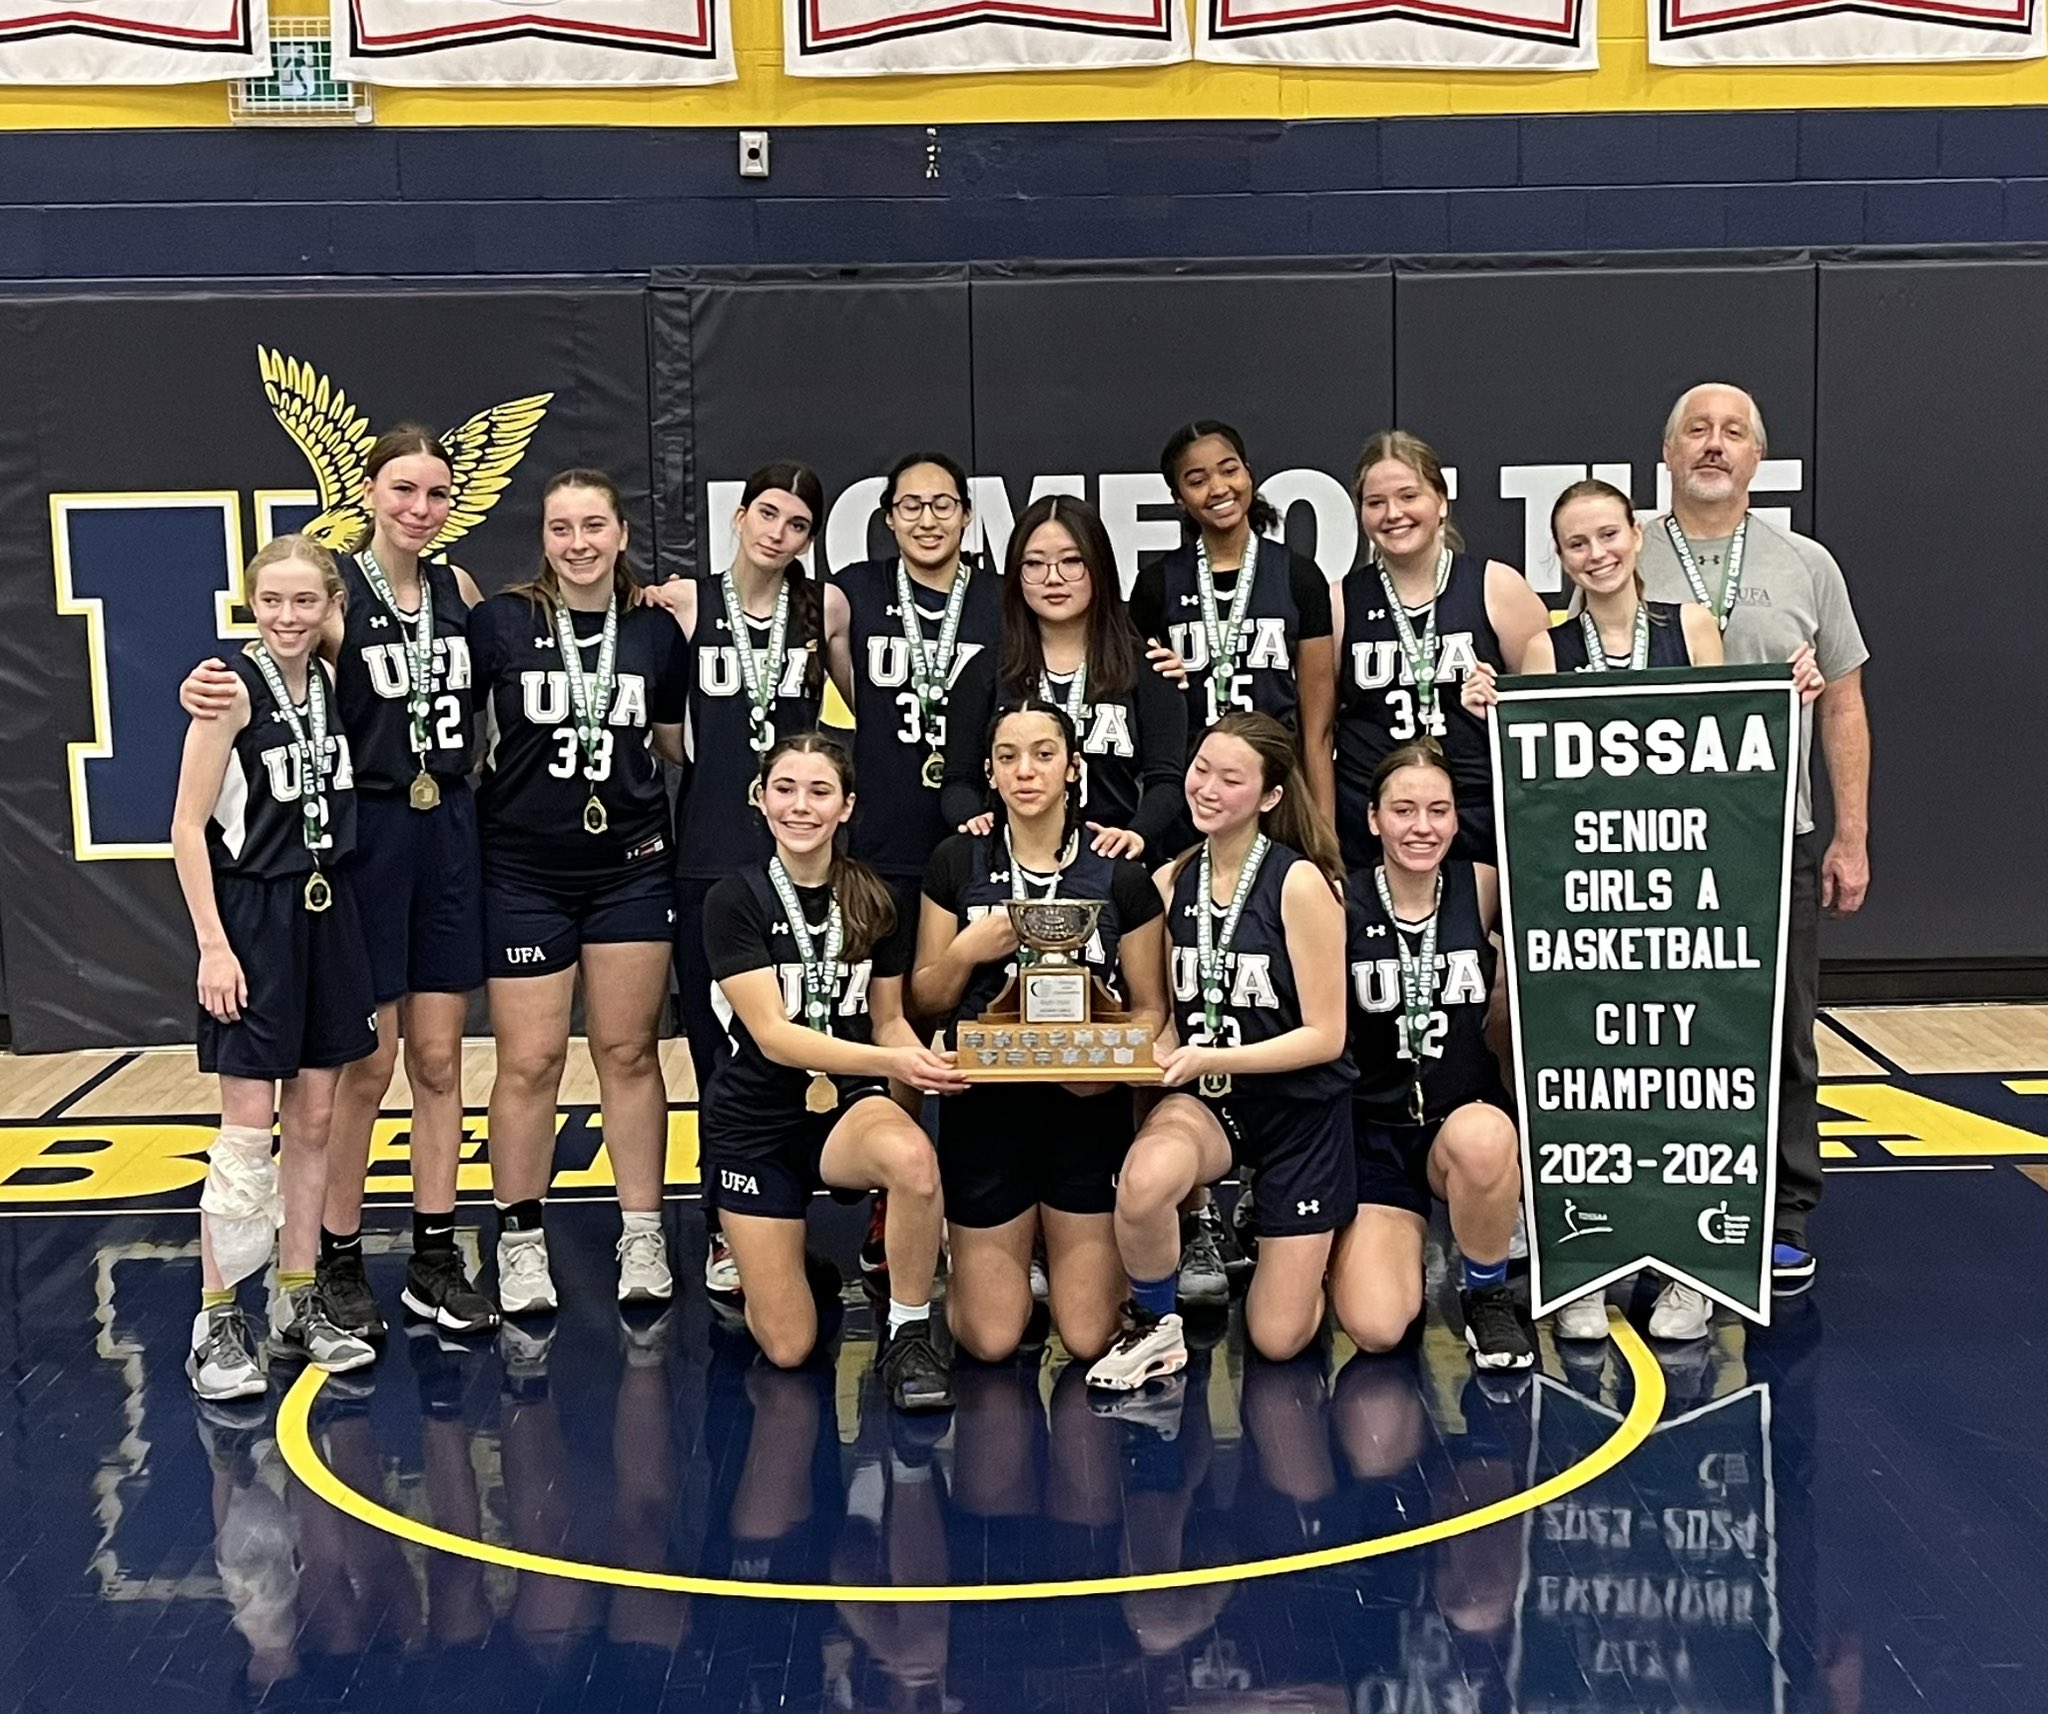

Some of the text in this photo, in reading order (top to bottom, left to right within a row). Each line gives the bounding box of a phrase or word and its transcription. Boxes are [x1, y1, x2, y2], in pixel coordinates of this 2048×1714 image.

[1203, 674, 1254, 727] 15
[1385, 690, 1447, 740] 34
[548, 727, 614, 782] 33
[1508, 714, 1777, 780] TDSSAA
[1574, 808, 1708, 855] SENIOR
[1220, 833, 1267, 945] CHAMPIONSHIPS
[1564, 867, 1720, 913] GIRLS A
[506, 946, 546, 963] UFA
[1526, 927, 1761, 972] BASKETBALL
[1395, 1011, 1449, 1060] 12
[1595, 1002, 1697, 1048] CITY
[1536, 1067, 1757, 1111] CHAMPIONS
[721, 1169, 760, 1195] UFA
[1539, 1142, 1760, 1186] 2023-2024
